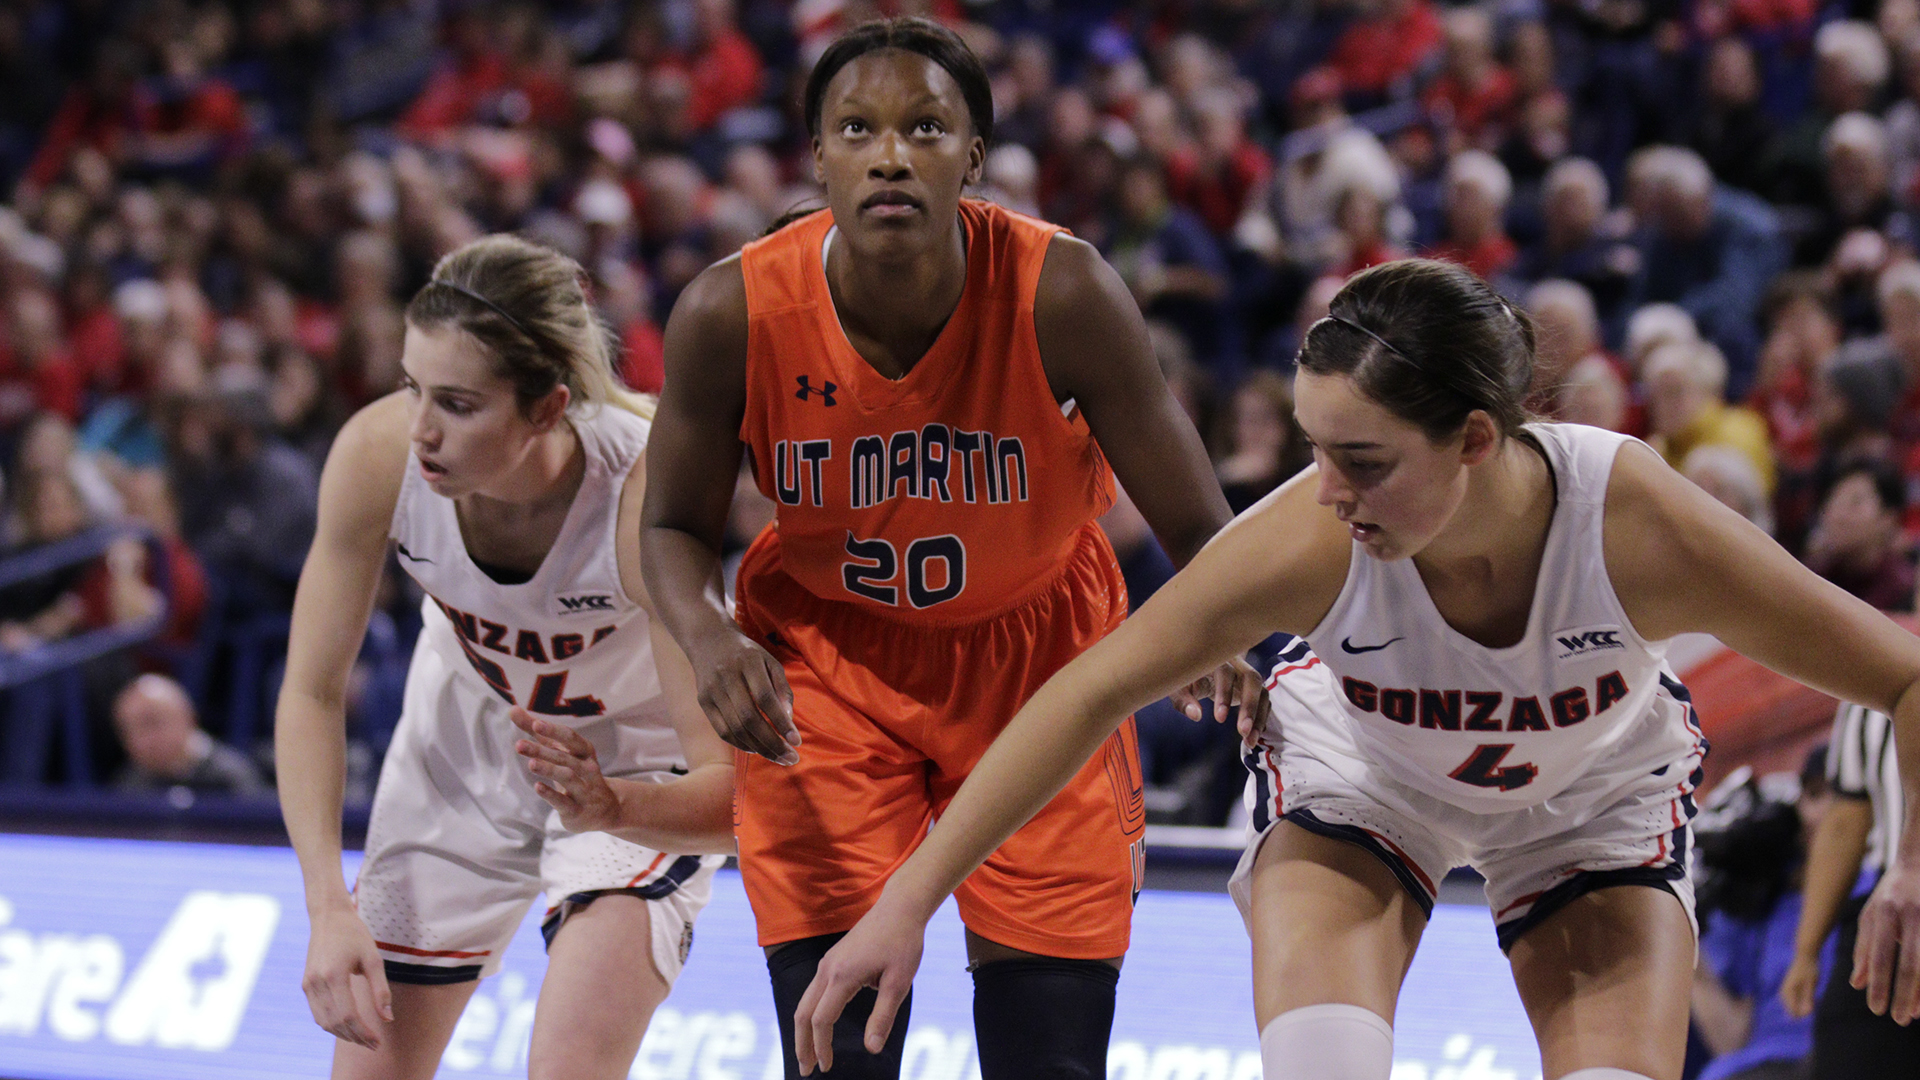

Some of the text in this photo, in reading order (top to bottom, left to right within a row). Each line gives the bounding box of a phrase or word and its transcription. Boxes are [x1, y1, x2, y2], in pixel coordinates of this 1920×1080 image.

[775, 423, 1029, 509] UT MARTIN
[841, 529, 966, 609] 20
[1557, 630, 1625, 651] WCC
[1342, 670, 1630, 732] GONZAGA
[1447, 743, 1538, 792] 4
